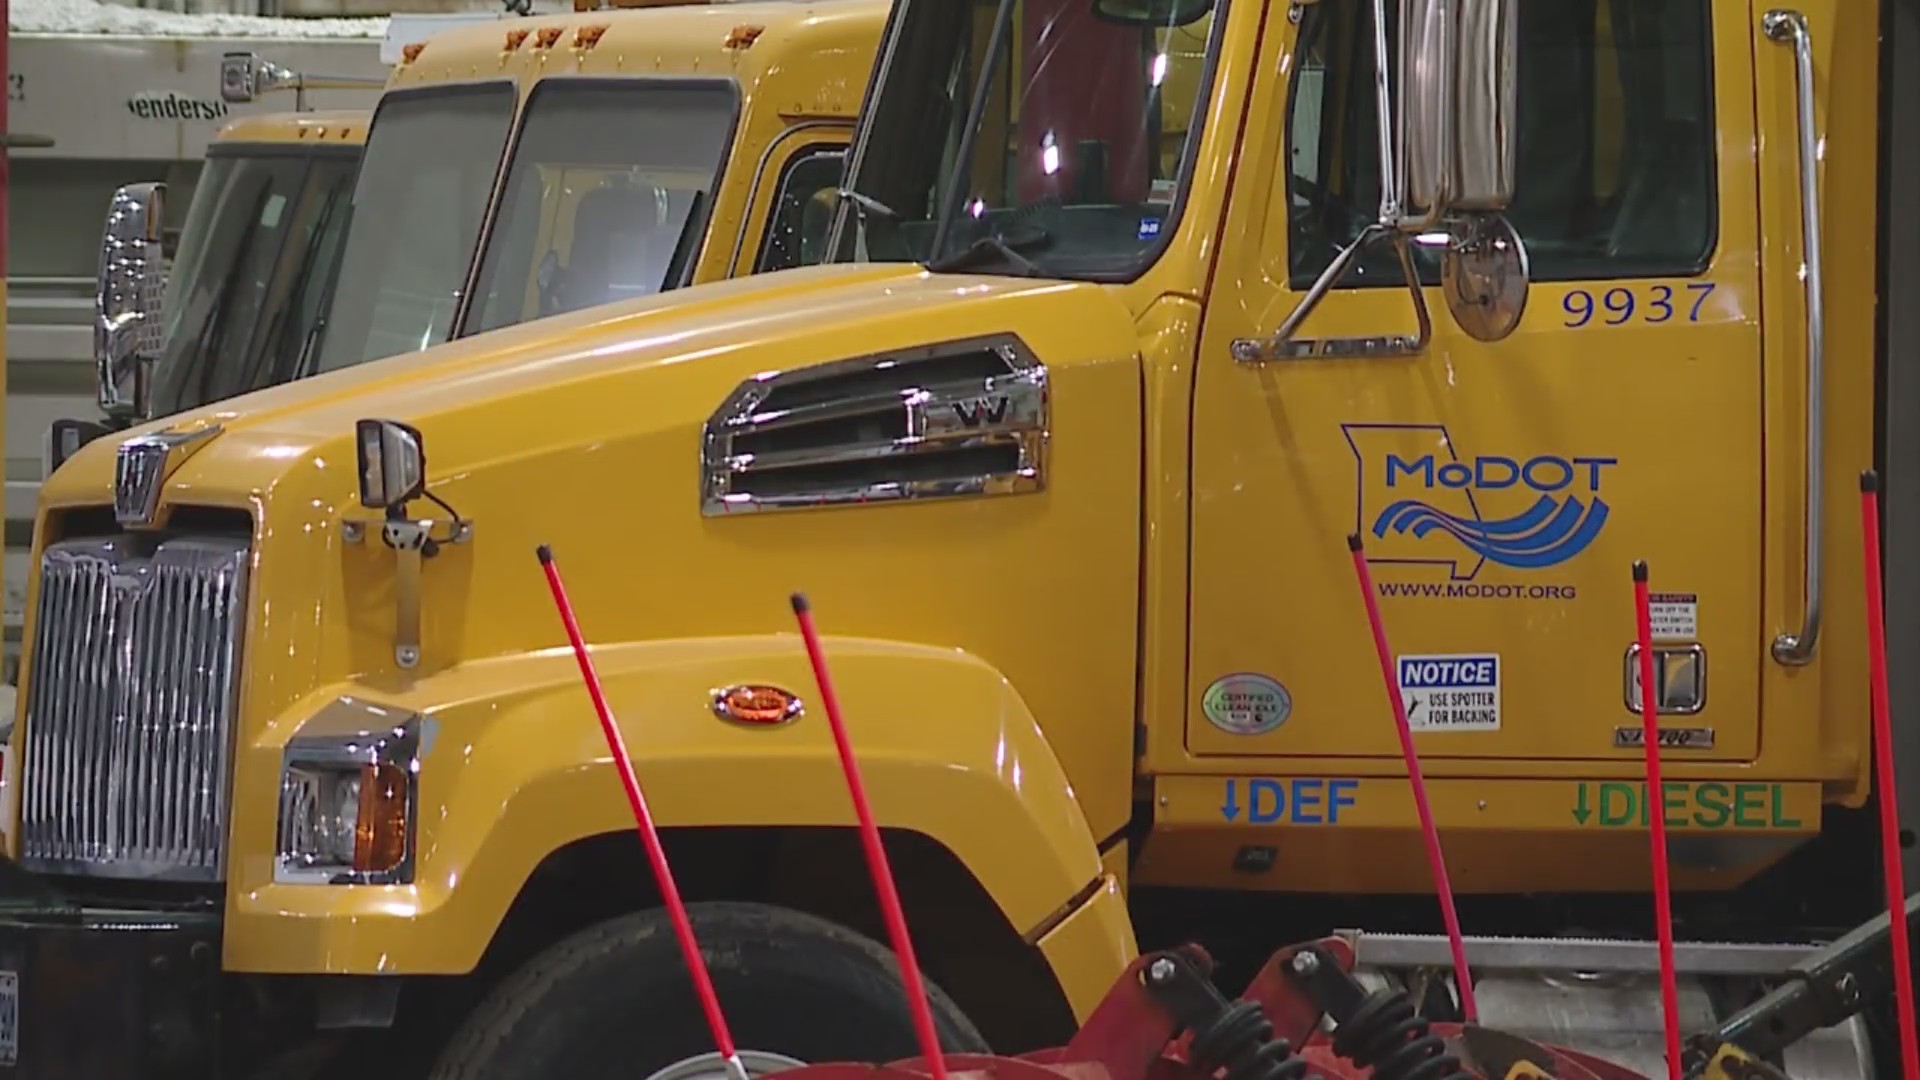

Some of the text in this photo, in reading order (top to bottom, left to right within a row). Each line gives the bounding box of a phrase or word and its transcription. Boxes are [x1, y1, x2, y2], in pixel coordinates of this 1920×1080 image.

[1562, 283, 1716, 328] 9937
[1386, 455, 1617, 491] MoDOT
[1379, 583, 1576, 599] WWW.MODOT.ORG
[1405, 661, 1492, 685] NOTICE
[1429, 691, 1495, 707] USE SPOTTER
[1429, 709, 1496, 724] FOR BACKING
[1249, 779, 1359, 824] DEF
[1599, 783, 1803, 828] DIESEL
